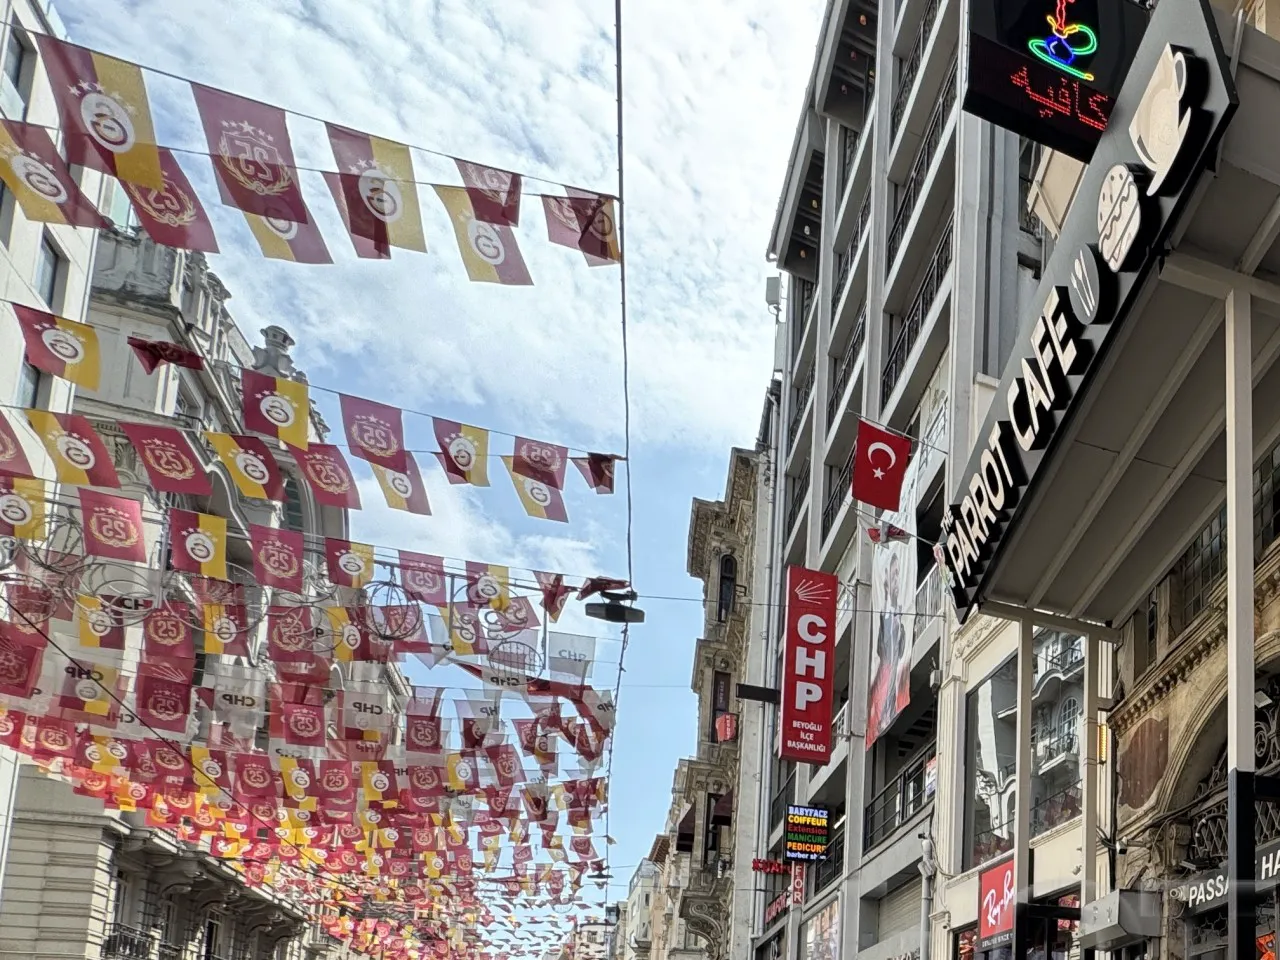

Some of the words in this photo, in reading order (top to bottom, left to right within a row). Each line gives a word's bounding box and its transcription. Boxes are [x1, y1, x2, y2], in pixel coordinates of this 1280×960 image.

[946, 420, 1014, 590] PARROT
[1007, 285, 1078, 452] CAFE
[795, 613, 828, 711] CHP
[792, 719, 823, 733] BEYOĞLU
[800, 729, 815, 741] İLÇE
[787, 739, 826, 753] BAŞKANLIĞI
[788, 806, 829, 819] BABYFACE
[788, 815, 828, 827] COIFFEUR
[787, 824, 828, 835] Extension
[787, 833, 827, 844] MANICURE
[786, 851, 809, 861] barber
